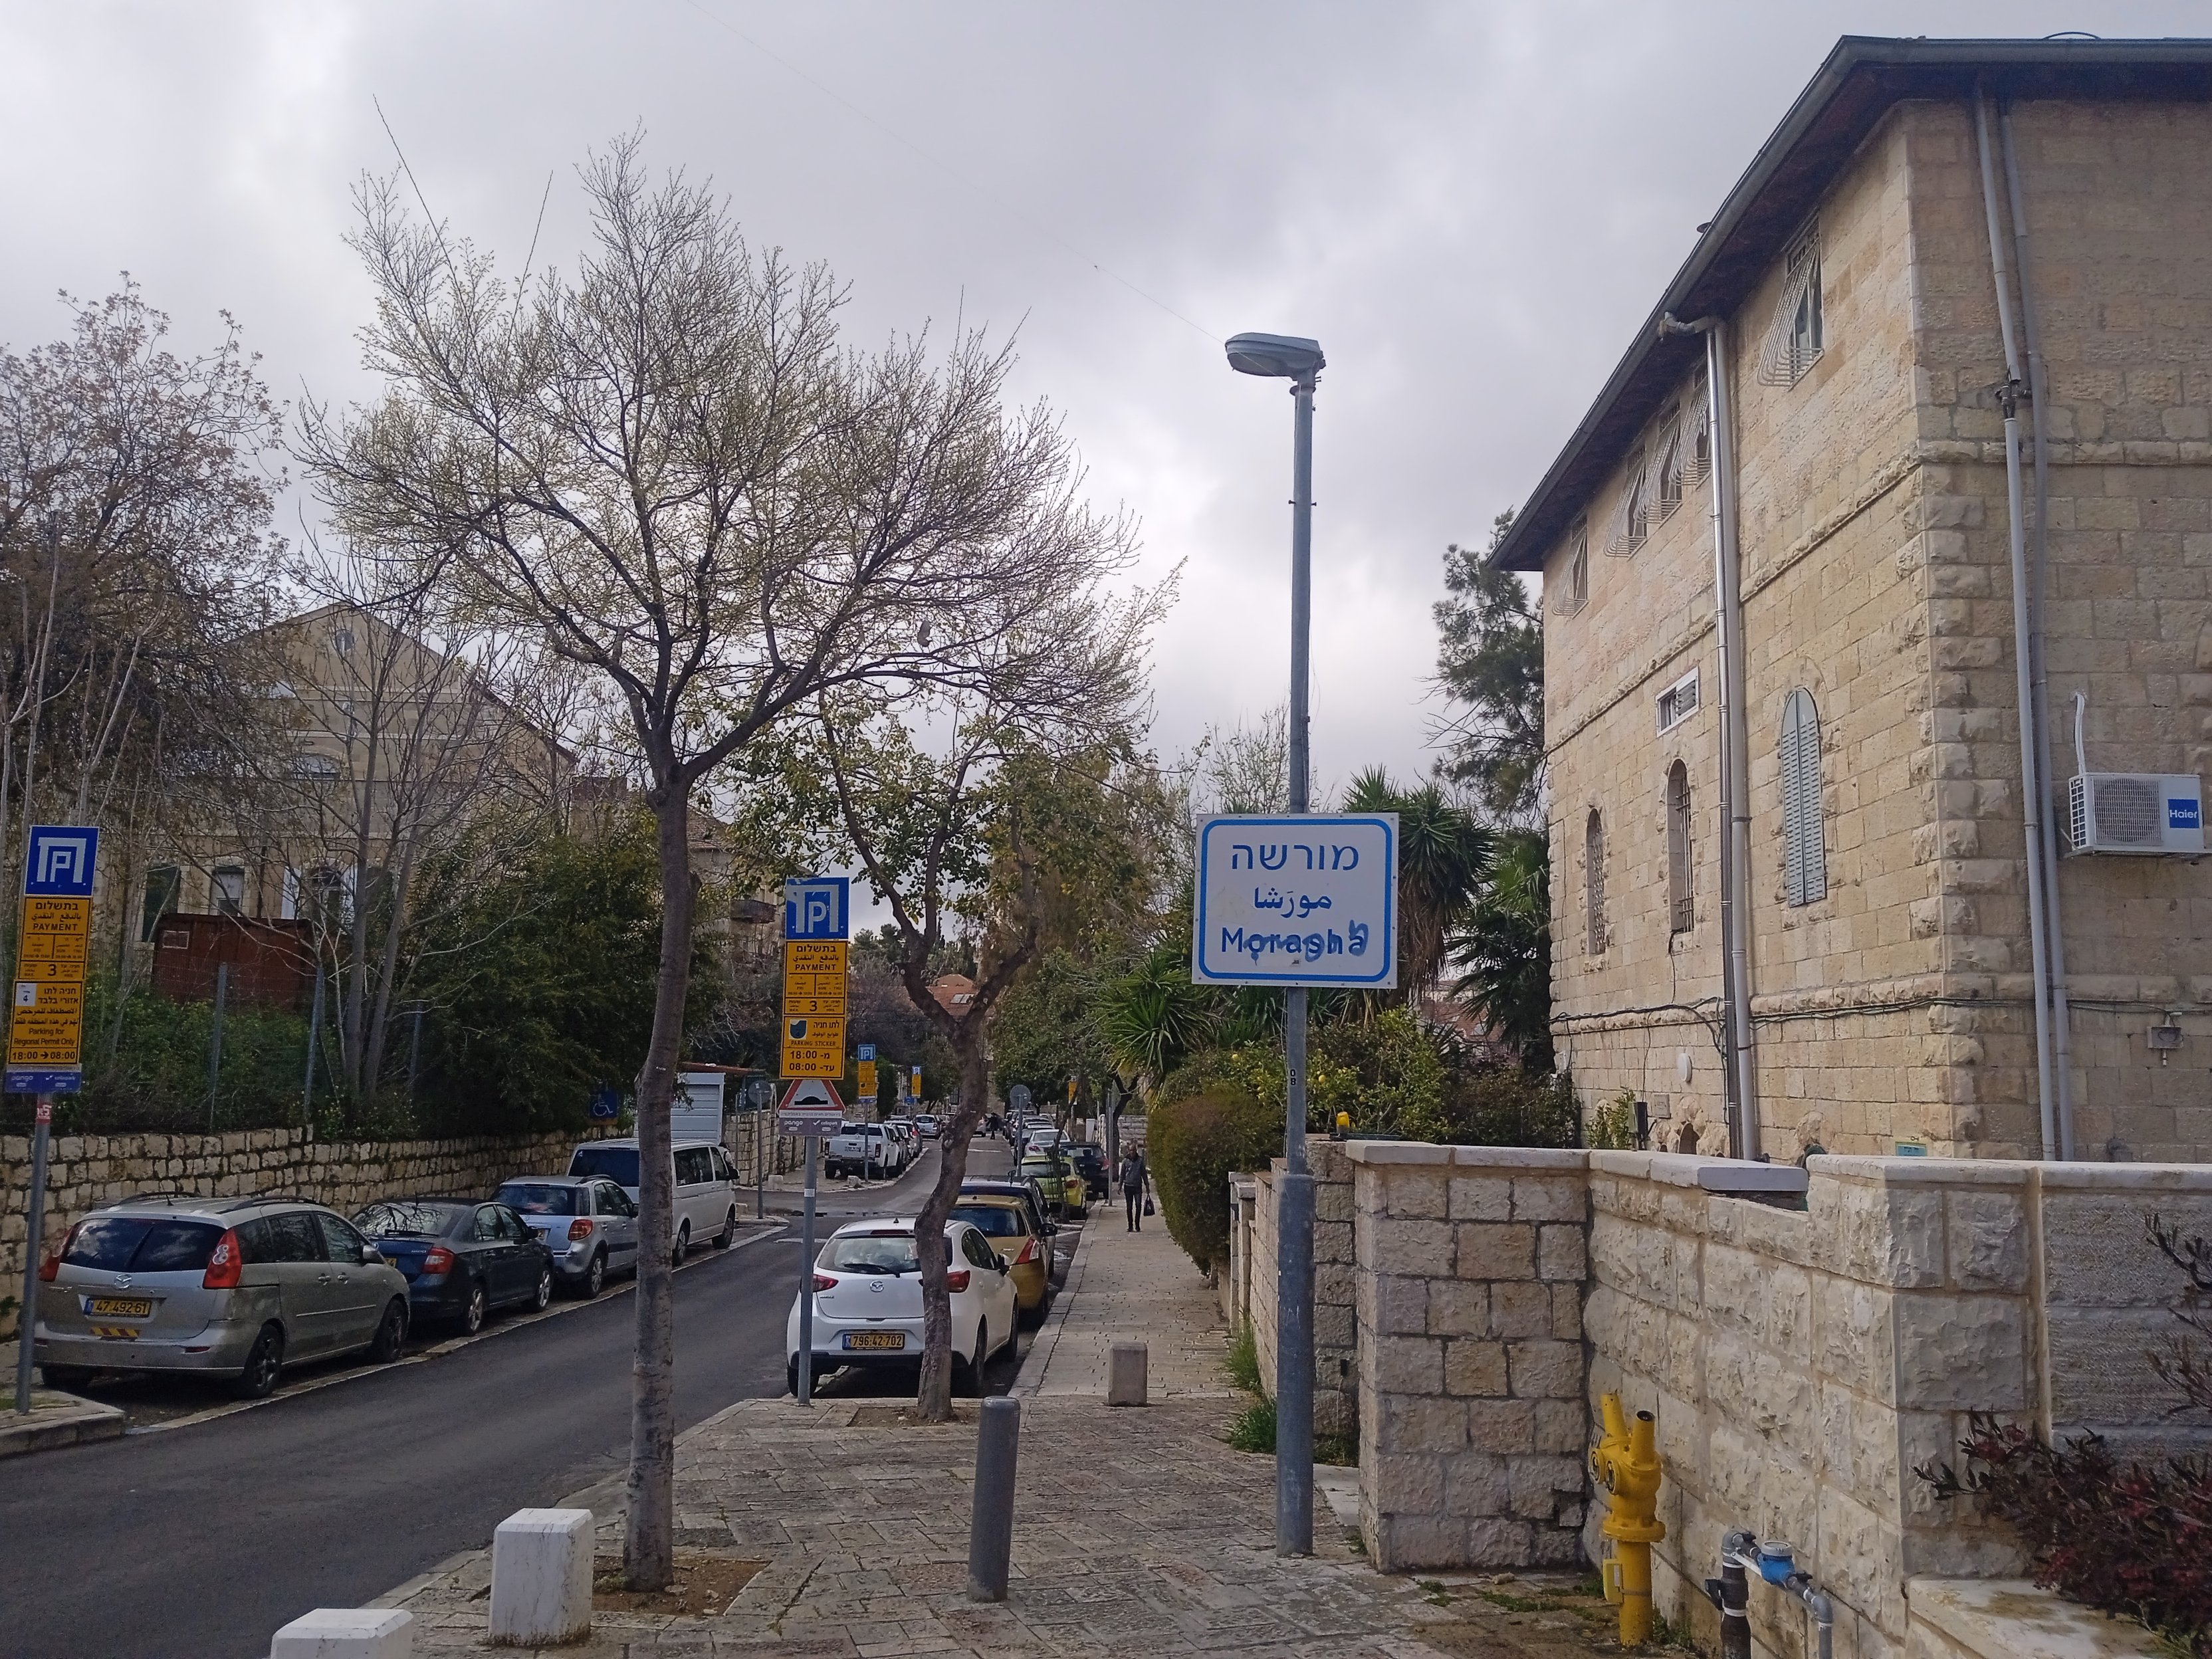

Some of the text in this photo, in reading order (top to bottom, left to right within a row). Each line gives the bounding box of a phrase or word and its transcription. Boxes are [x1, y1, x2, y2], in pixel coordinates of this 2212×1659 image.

[2169, 809, 2197, 818] Haier
[1232, 844, 1359, 871] מורשה
[35, 901, 78, 910] בתשלום
[1222, 925, 1367, 956] Morasha
[820, 954, 839, 963] بالدفع
[48, 964, 56, 976] 3
[39, 996, 58, 1004] בלבד
[809, 1000, 818, 1012] 3
[14, 1038, 39, 1046] Regional
